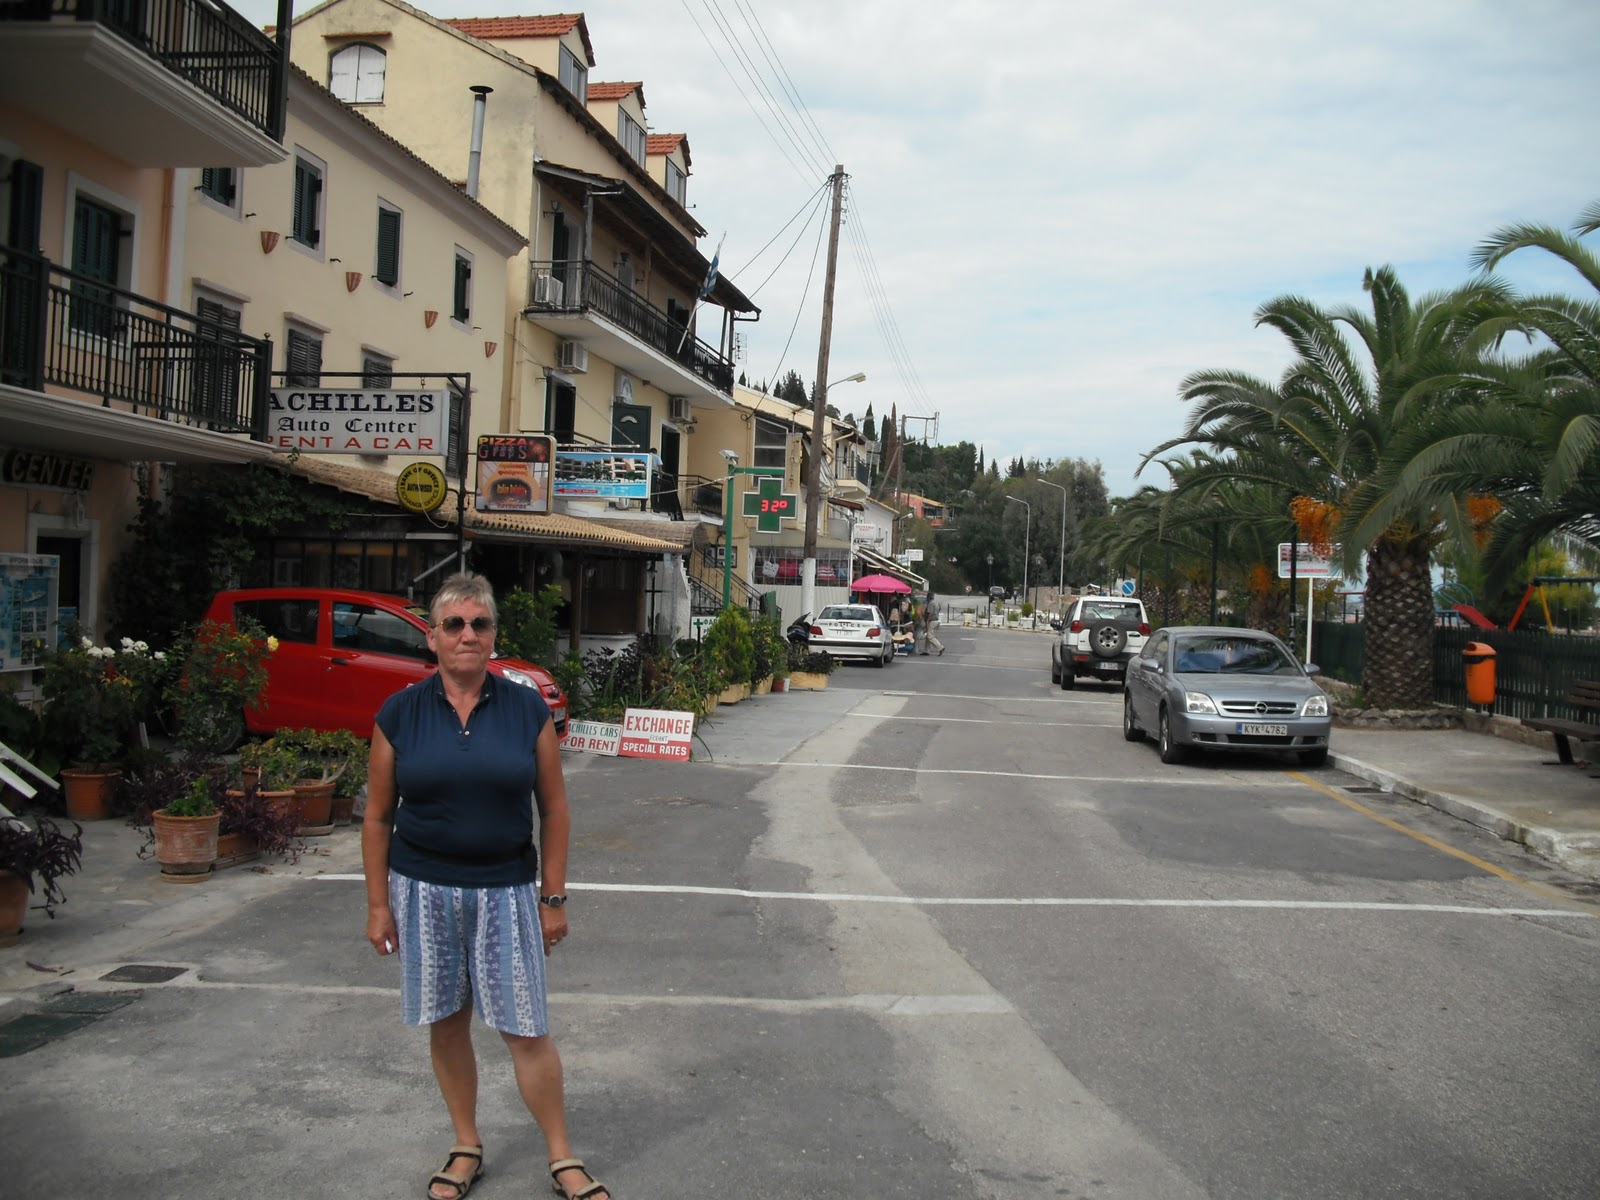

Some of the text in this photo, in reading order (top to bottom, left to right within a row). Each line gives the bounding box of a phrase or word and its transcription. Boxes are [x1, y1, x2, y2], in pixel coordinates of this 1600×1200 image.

[269, 392, 434, 413] ACHILLES
[277, 416, 418, 433] Auto Center
[344, 437, 362, 449] A
[373, 437, 433, 450] CAR
[478, 437, 528, 446] PIZZA
[11, 452, 96, 491] CENTER
[400, 470, 413, 486] BANK
[599, 727, 619, 739] CARS
[626, 715, 690, 735] EXCHANGE
[563, 735, 617, 752] FOR RENT
[622, 742, 687, 756] SPECIAL RATES
